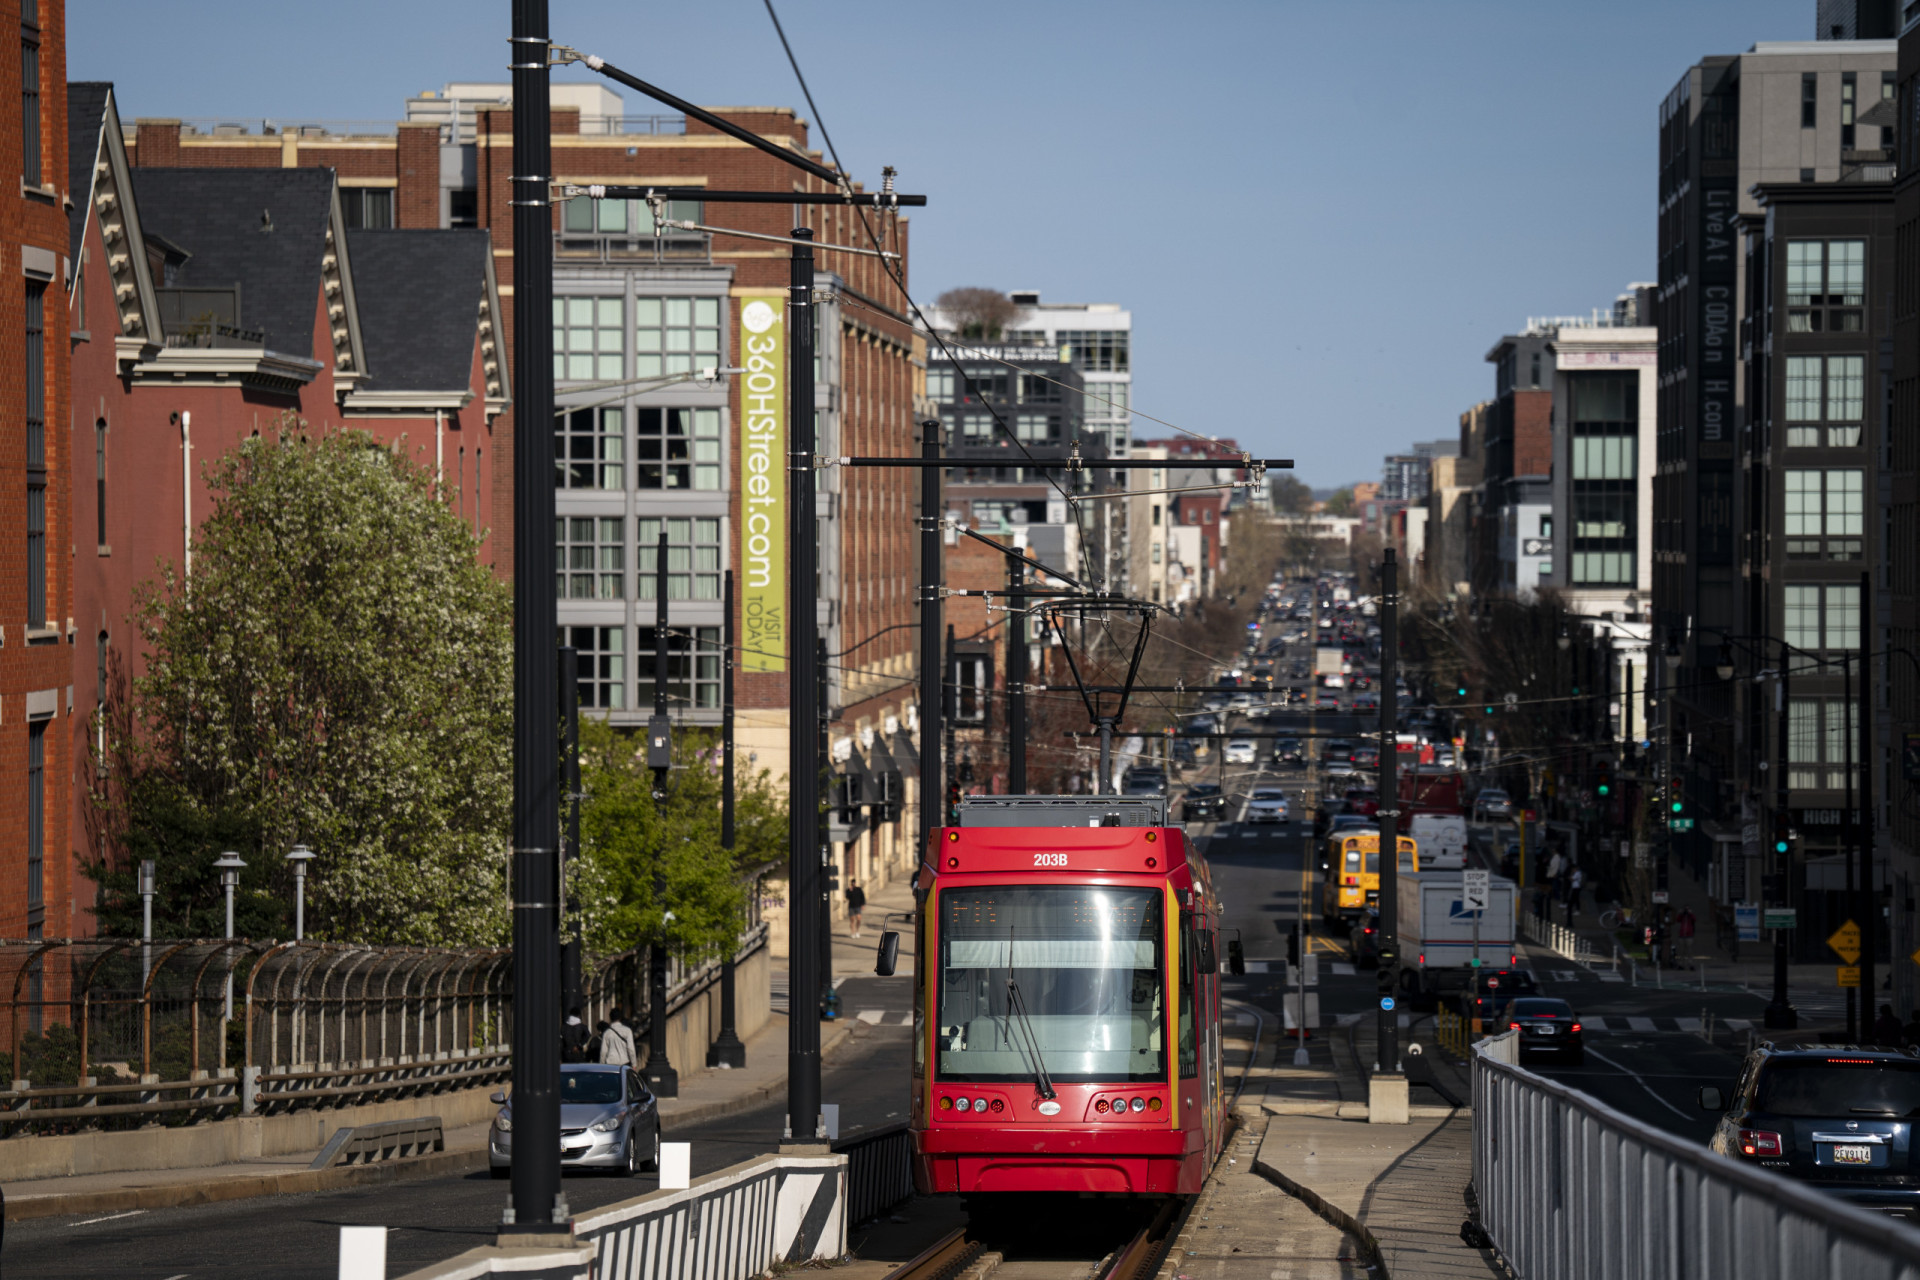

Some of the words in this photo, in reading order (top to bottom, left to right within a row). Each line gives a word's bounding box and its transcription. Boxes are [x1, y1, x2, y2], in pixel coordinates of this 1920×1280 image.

[747, 335, 776, 588] 360HStreet.com
[764, 607, 781, 642] VISIT
[1803, 809, 1841, 825] HIGH
[1033, 853, 1068, 866] 203B
